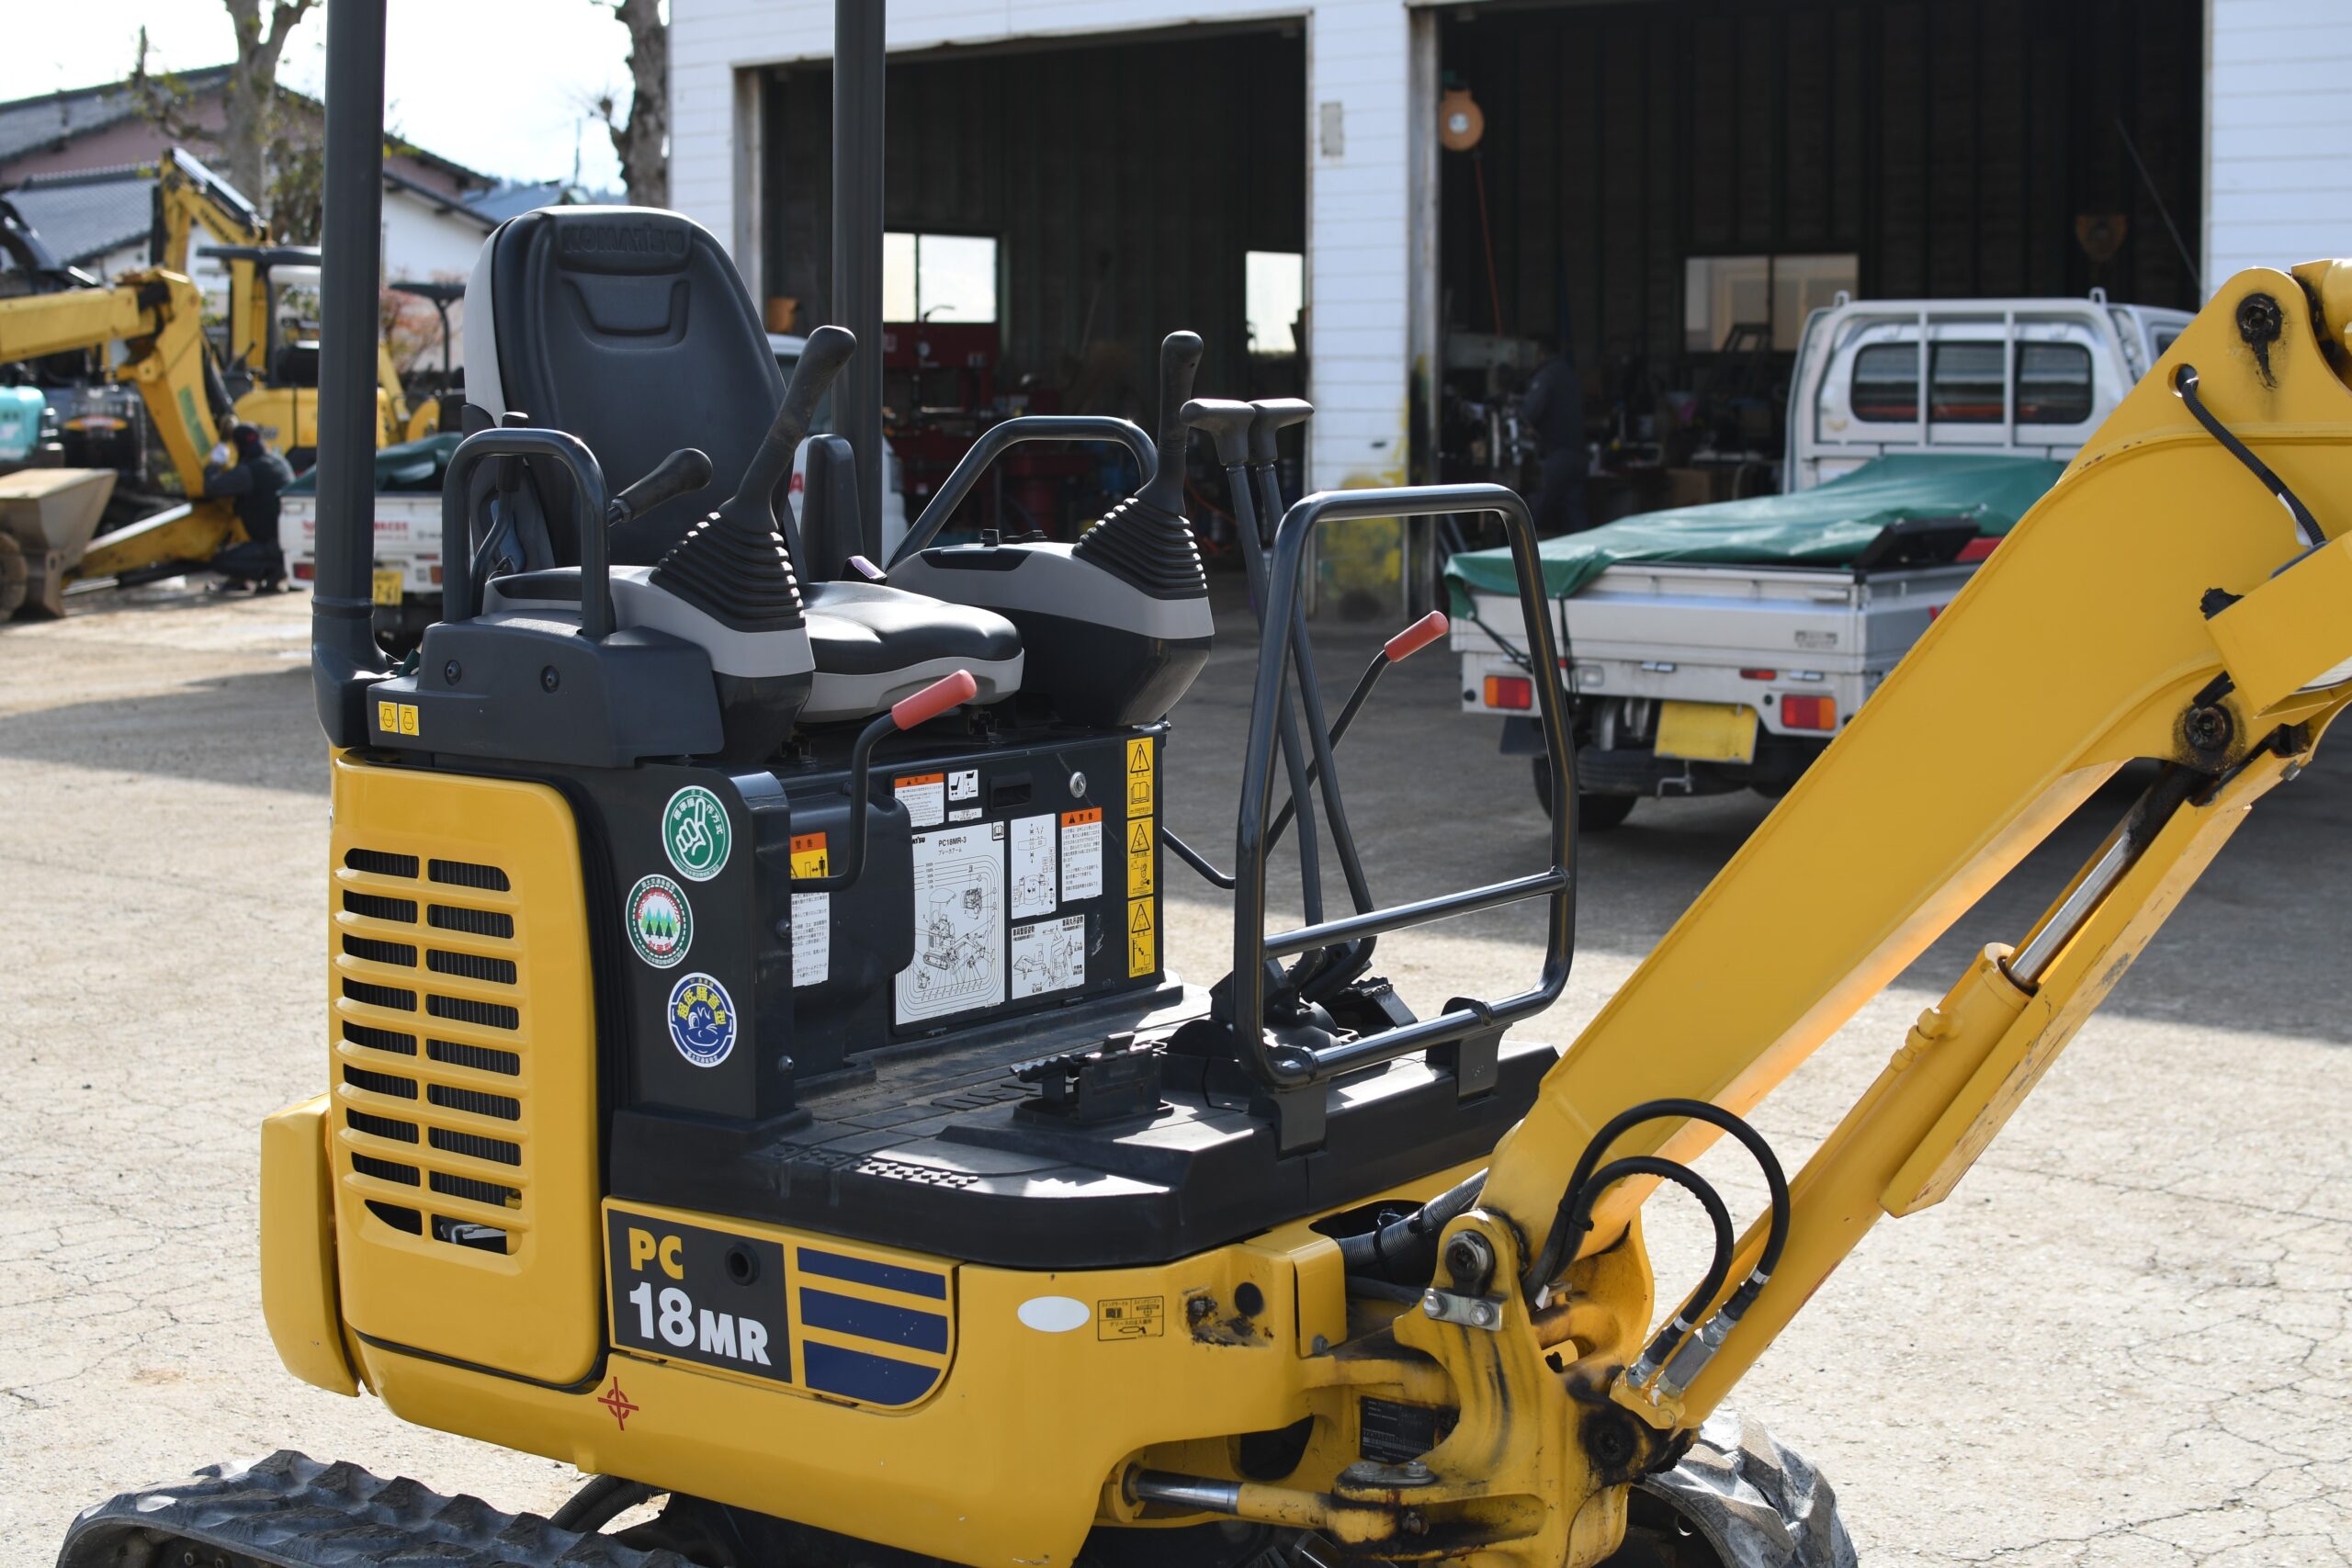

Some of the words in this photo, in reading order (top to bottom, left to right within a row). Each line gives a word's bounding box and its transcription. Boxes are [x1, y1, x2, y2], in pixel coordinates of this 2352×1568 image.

[561, 222, 687, 256] KOMATSU
[938, 836, 967, 847] PC18MR-3
[628, 1227, 684, 1280] PC
[629, 1281, 772, 1366] 18MR
